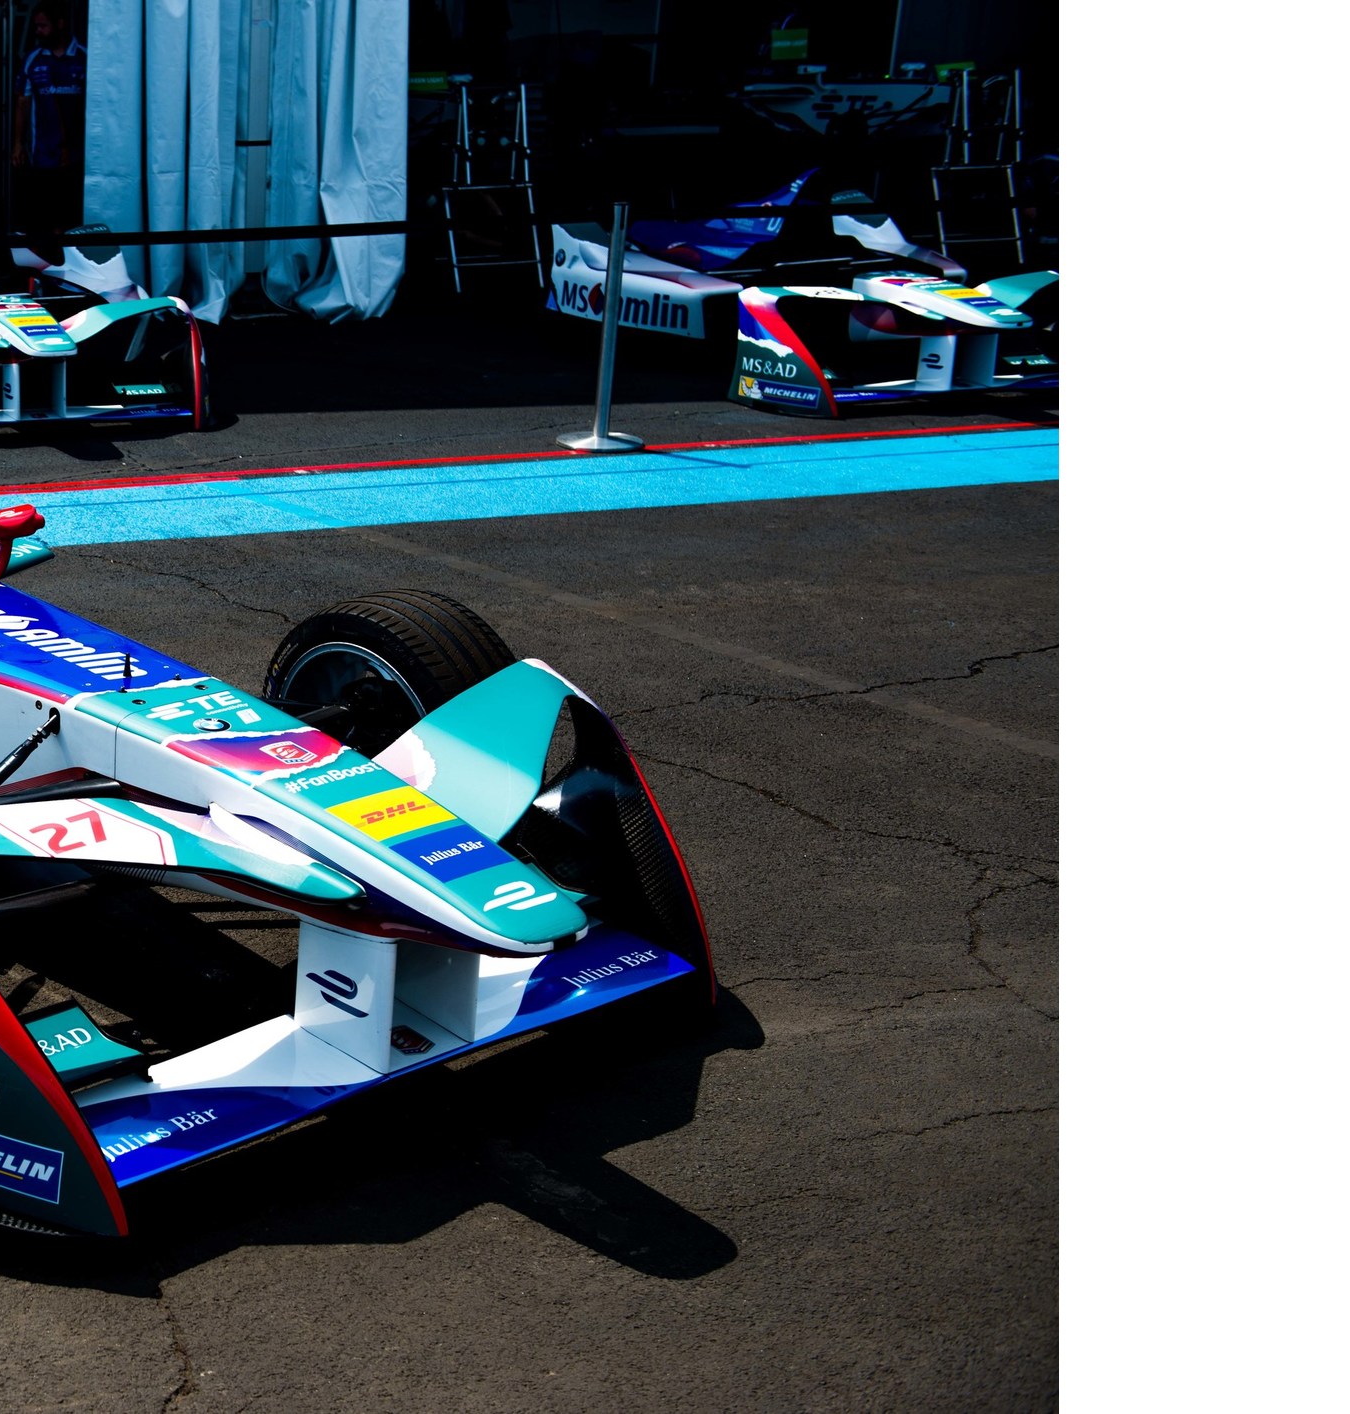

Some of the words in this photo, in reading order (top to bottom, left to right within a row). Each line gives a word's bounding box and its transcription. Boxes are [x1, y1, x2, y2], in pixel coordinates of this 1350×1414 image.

[561, 280, 589, 313] MS
[619, 293, 689, 329] mlin
[742, 356, 797, 378] MS&AD
[763, 386, 817, 401] MICHELIN
[187, 690, 242, 711] TE
[284, 761, 384, 794] #FanBoost
[361, 800, 426, 825] DHL
[29, 809, 107, 854] 27
[420, 848, 462, 866] Julius
[458, 839, 485, 853] Bär
[561, 963, 624, 989] Julius
[616, 949, 659, 967] Bär
[168, 1108, 219, 1131] Bär
